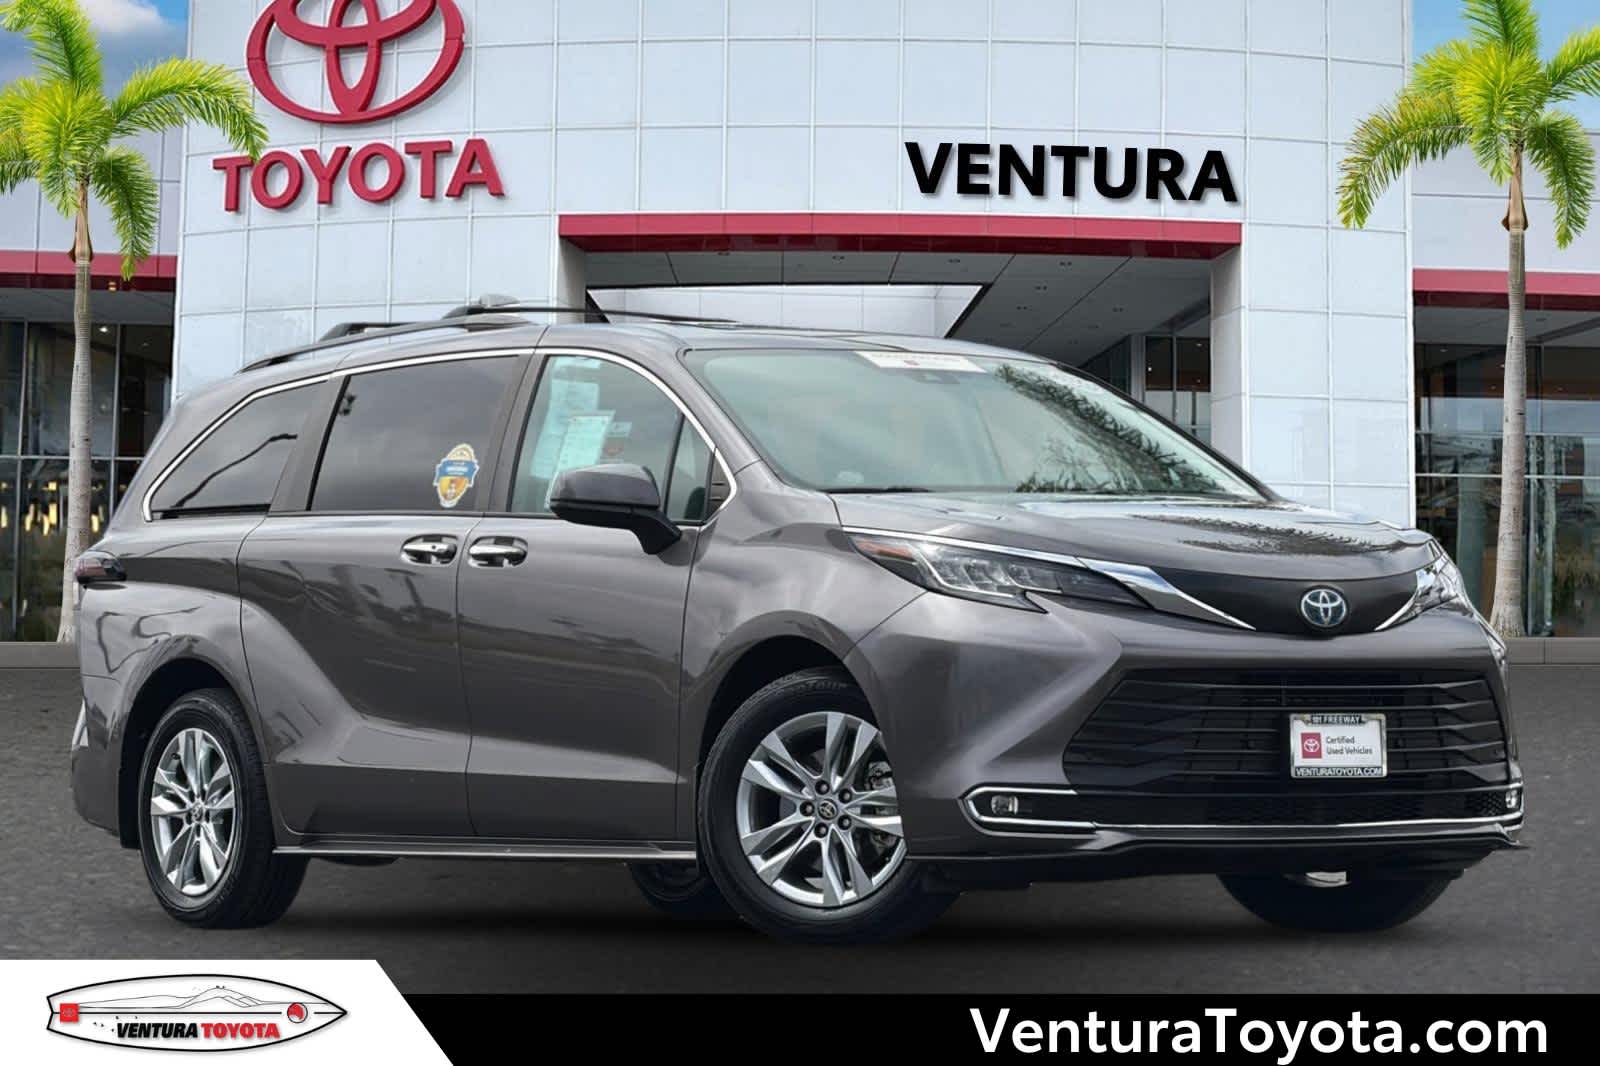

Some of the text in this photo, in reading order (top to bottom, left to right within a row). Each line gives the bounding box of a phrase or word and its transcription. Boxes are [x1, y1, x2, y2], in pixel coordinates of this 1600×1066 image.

[213, 138, 504, 212] TOYOTA
[904, 141, 1238, 202] VENTURA
[1324, 715, 1360, 724] FREEWAY
[1326, 736, 1355, 744] Certified
[1326, 747, 1373, 755] Used Vehicles
